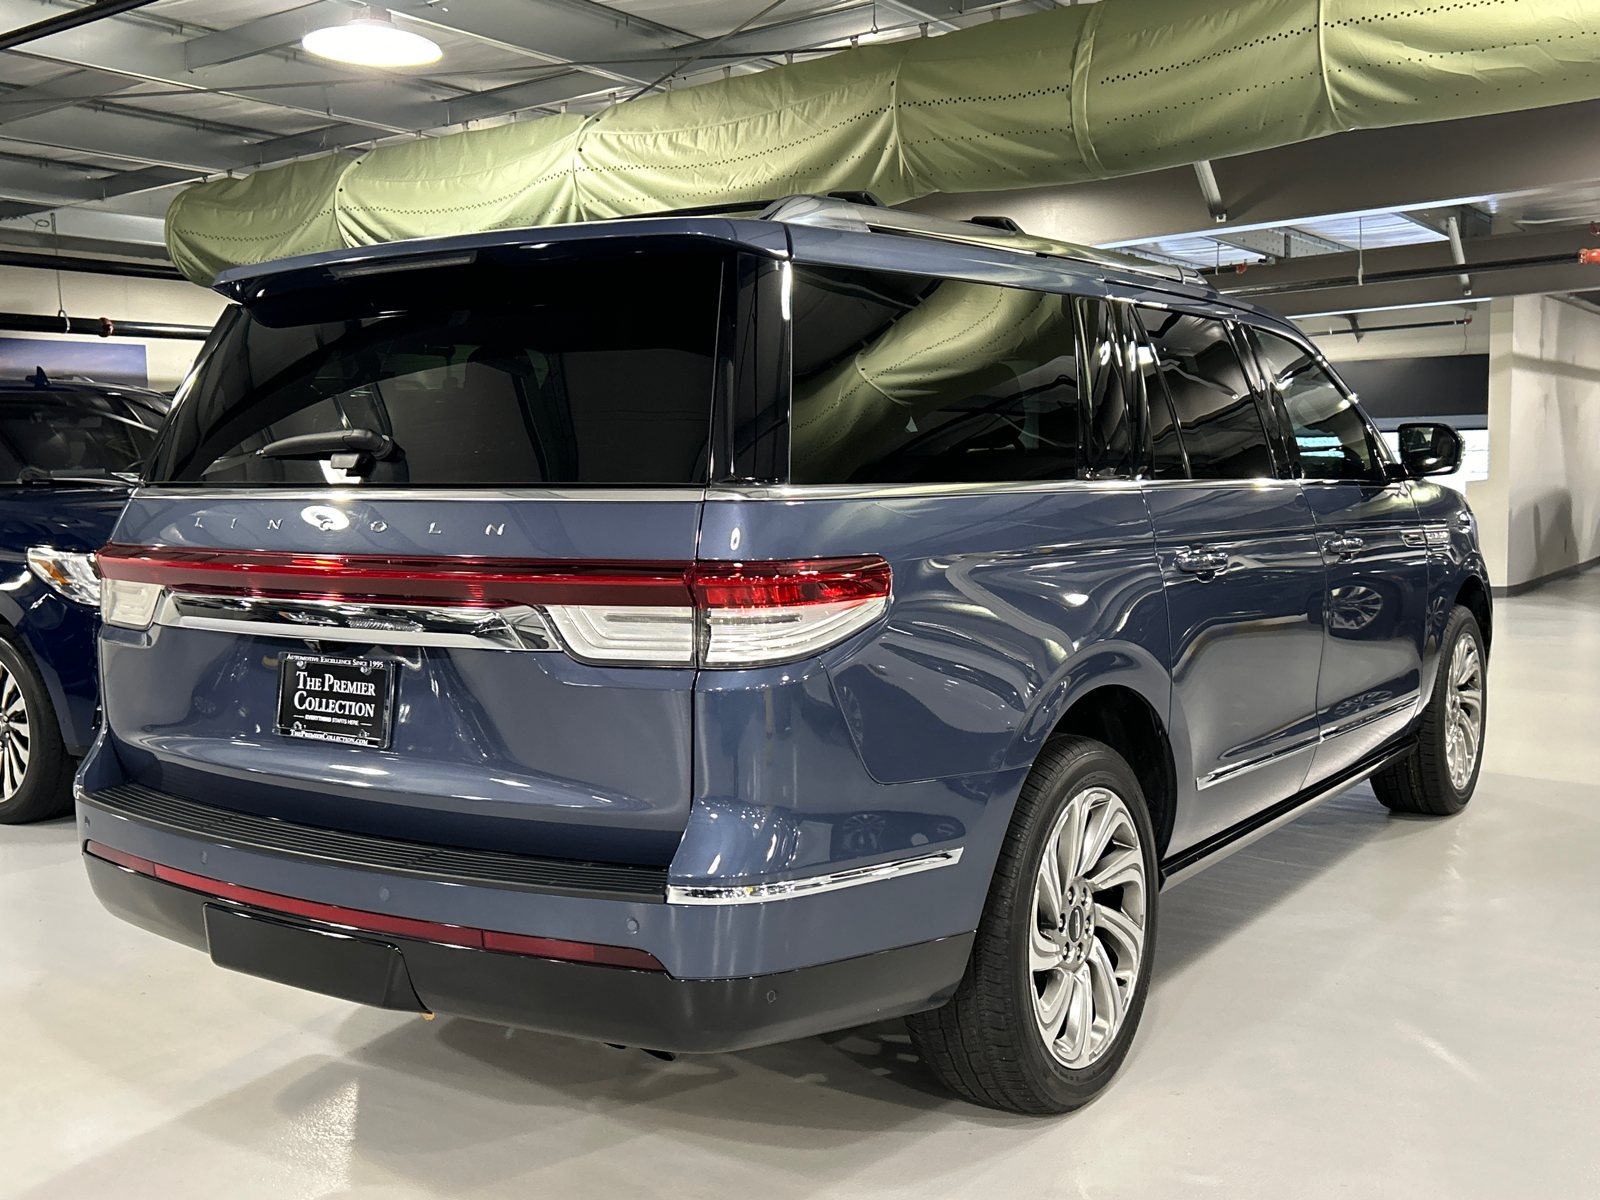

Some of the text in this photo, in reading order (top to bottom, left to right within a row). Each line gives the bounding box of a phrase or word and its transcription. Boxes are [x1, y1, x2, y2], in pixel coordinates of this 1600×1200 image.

[296, 671, 376, 697] THE PREMIER
[293, 690, 376, 718] COLLECTION
